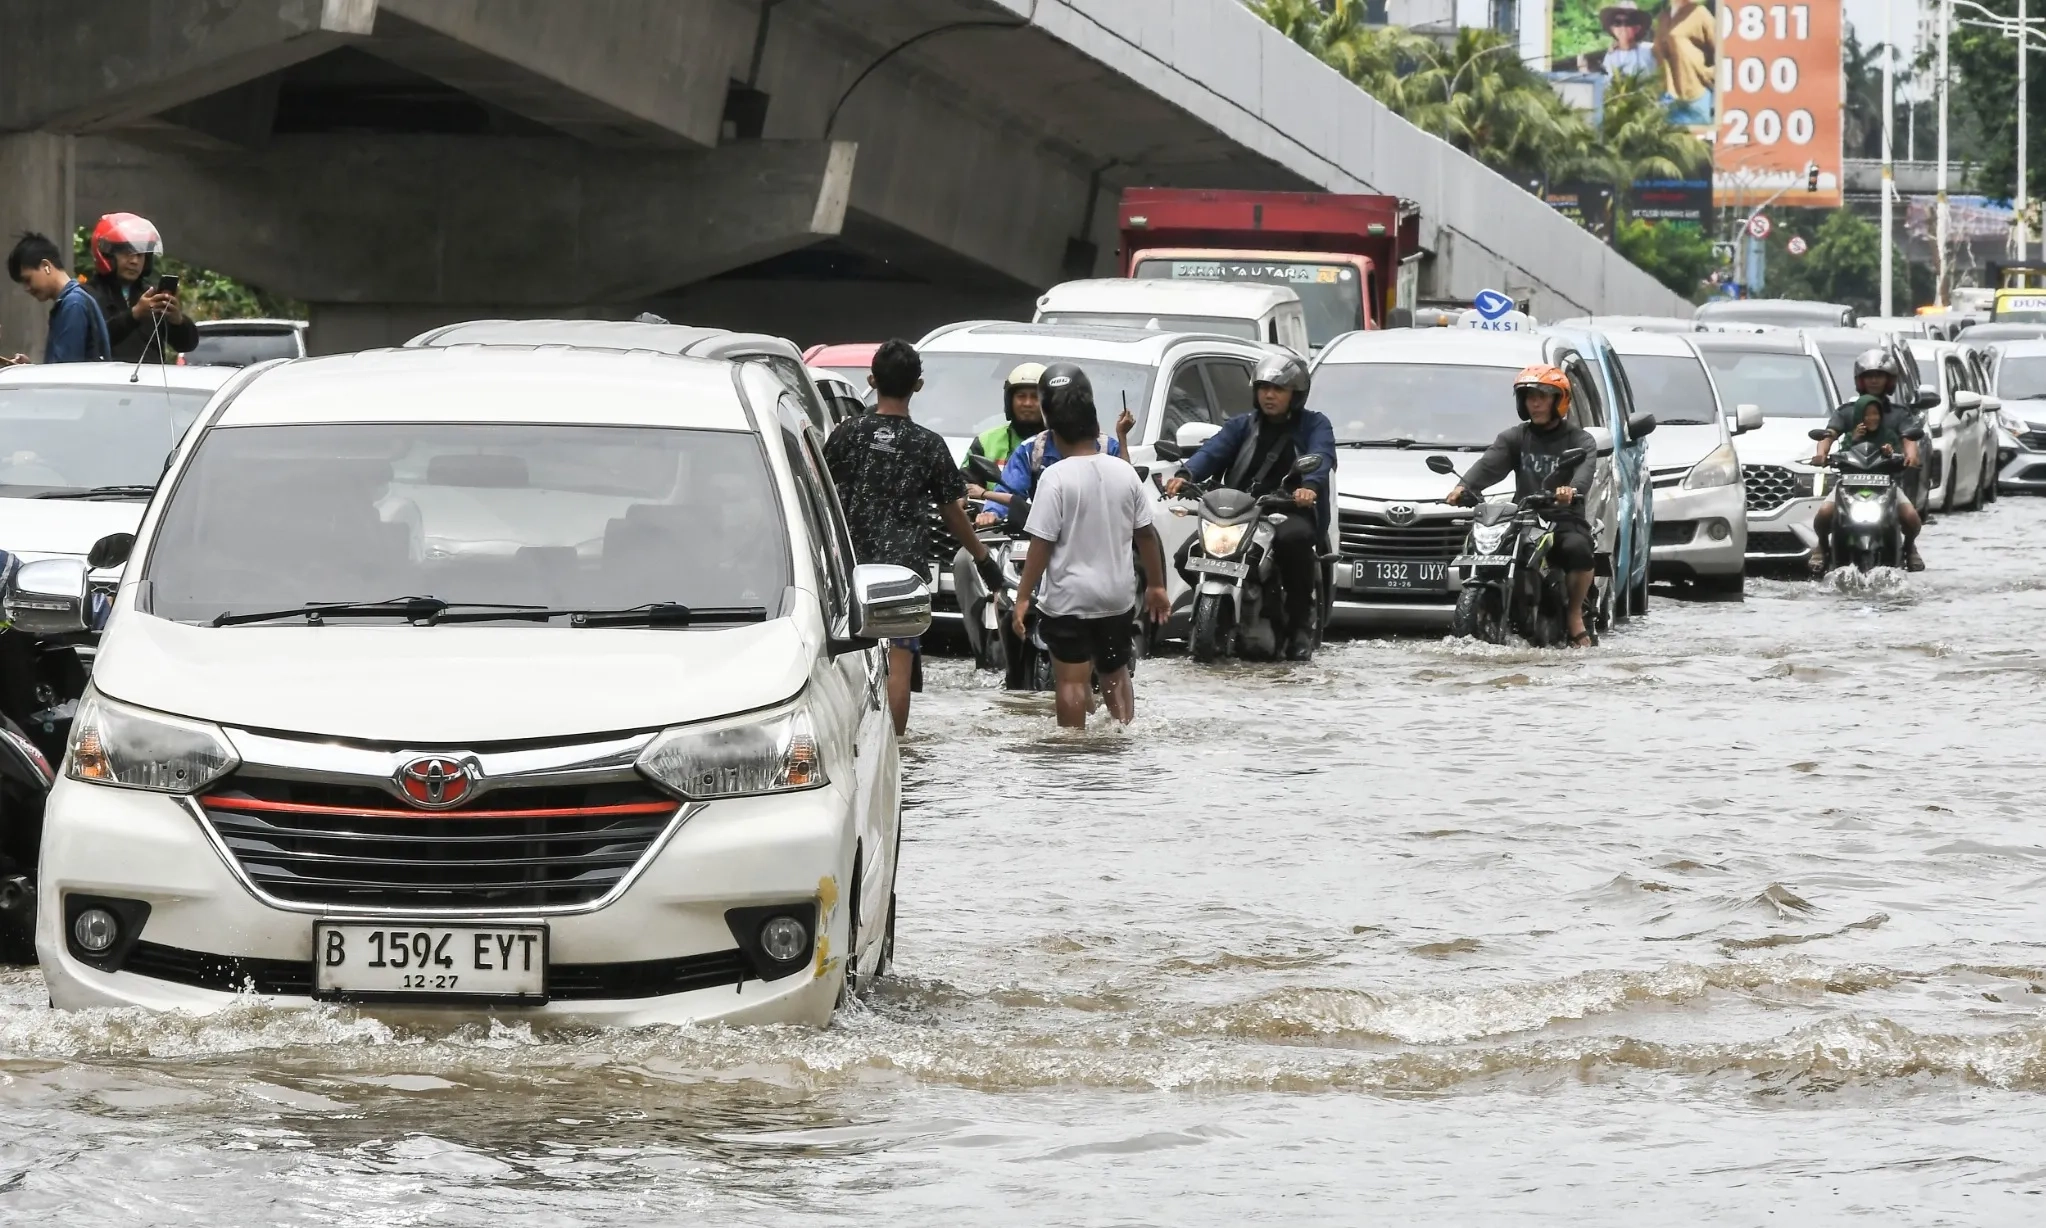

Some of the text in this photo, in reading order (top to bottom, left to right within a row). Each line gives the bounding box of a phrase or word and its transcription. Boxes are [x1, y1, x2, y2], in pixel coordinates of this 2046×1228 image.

[1722, 109, 1814, 145] 200
[1251, 266, 1309, 279] UTARA
[1470, 321, 1519, 331] TAKSI
[1355, 563, 1445, 580] B 1332 UYX
[326, 930, 538, 971] B 1594 EYT
